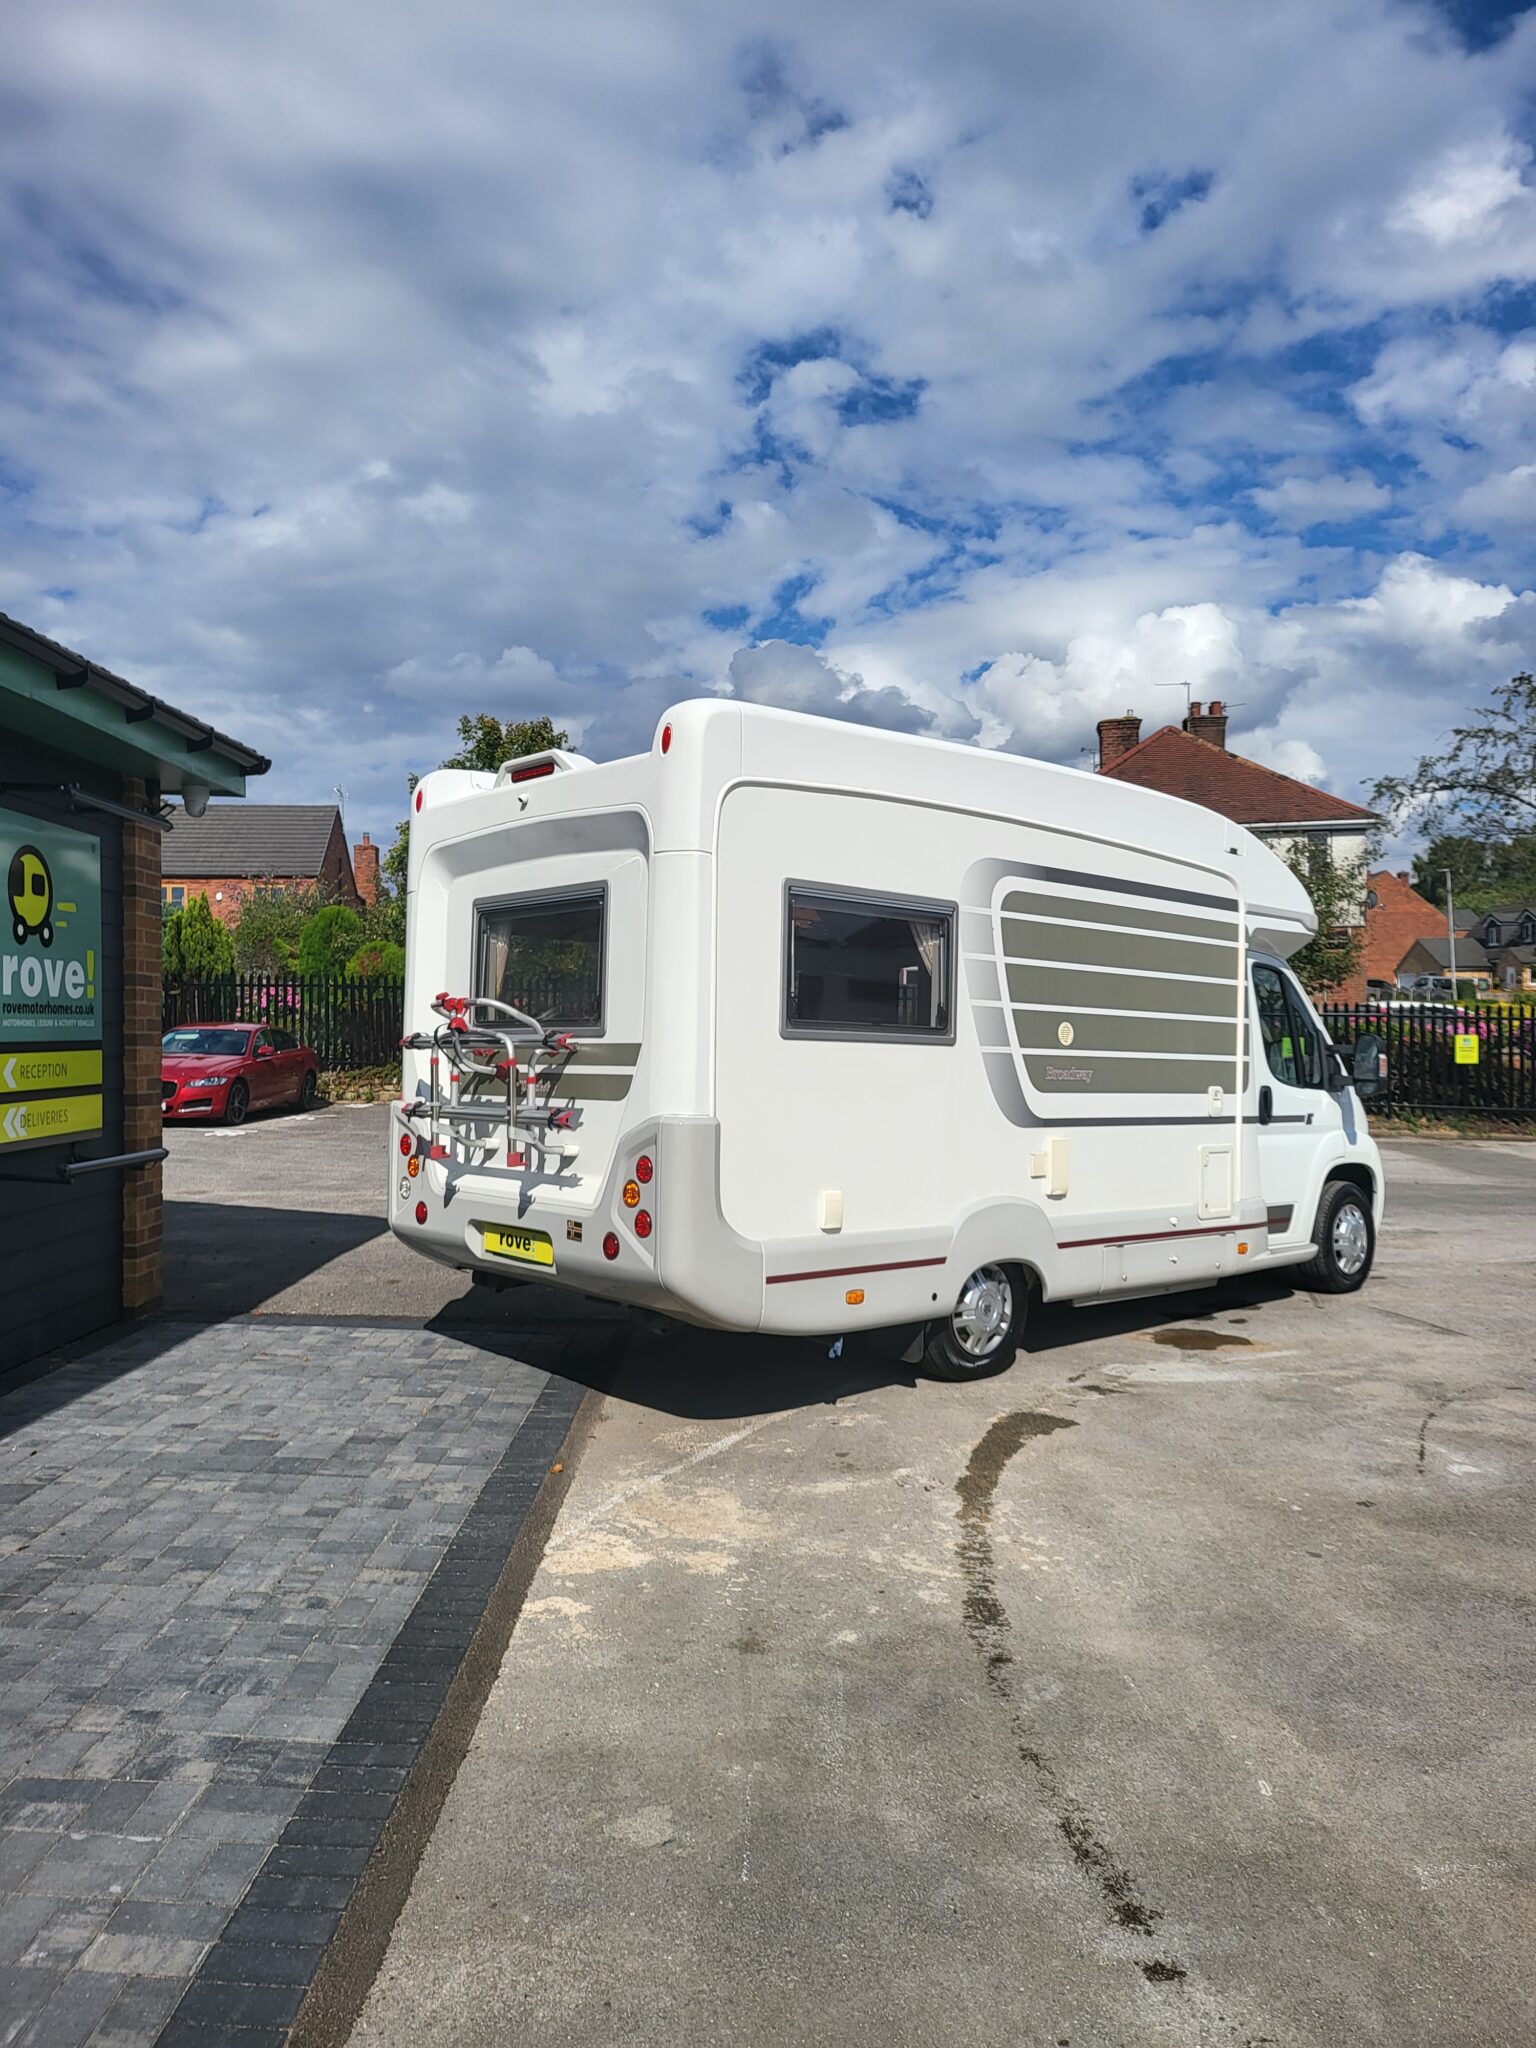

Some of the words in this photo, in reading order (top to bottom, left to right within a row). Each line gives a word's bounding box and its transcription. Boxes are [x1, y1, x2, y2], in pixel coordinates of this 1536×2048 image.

[2, 949, 95, 999] rove!
[2, 1001, 95, 1015] rovemotorhomes.co.uk
[20, 1063, 68, 1079] RECEPTION
[20, 1108, 69, 1129] DELIVERIES
